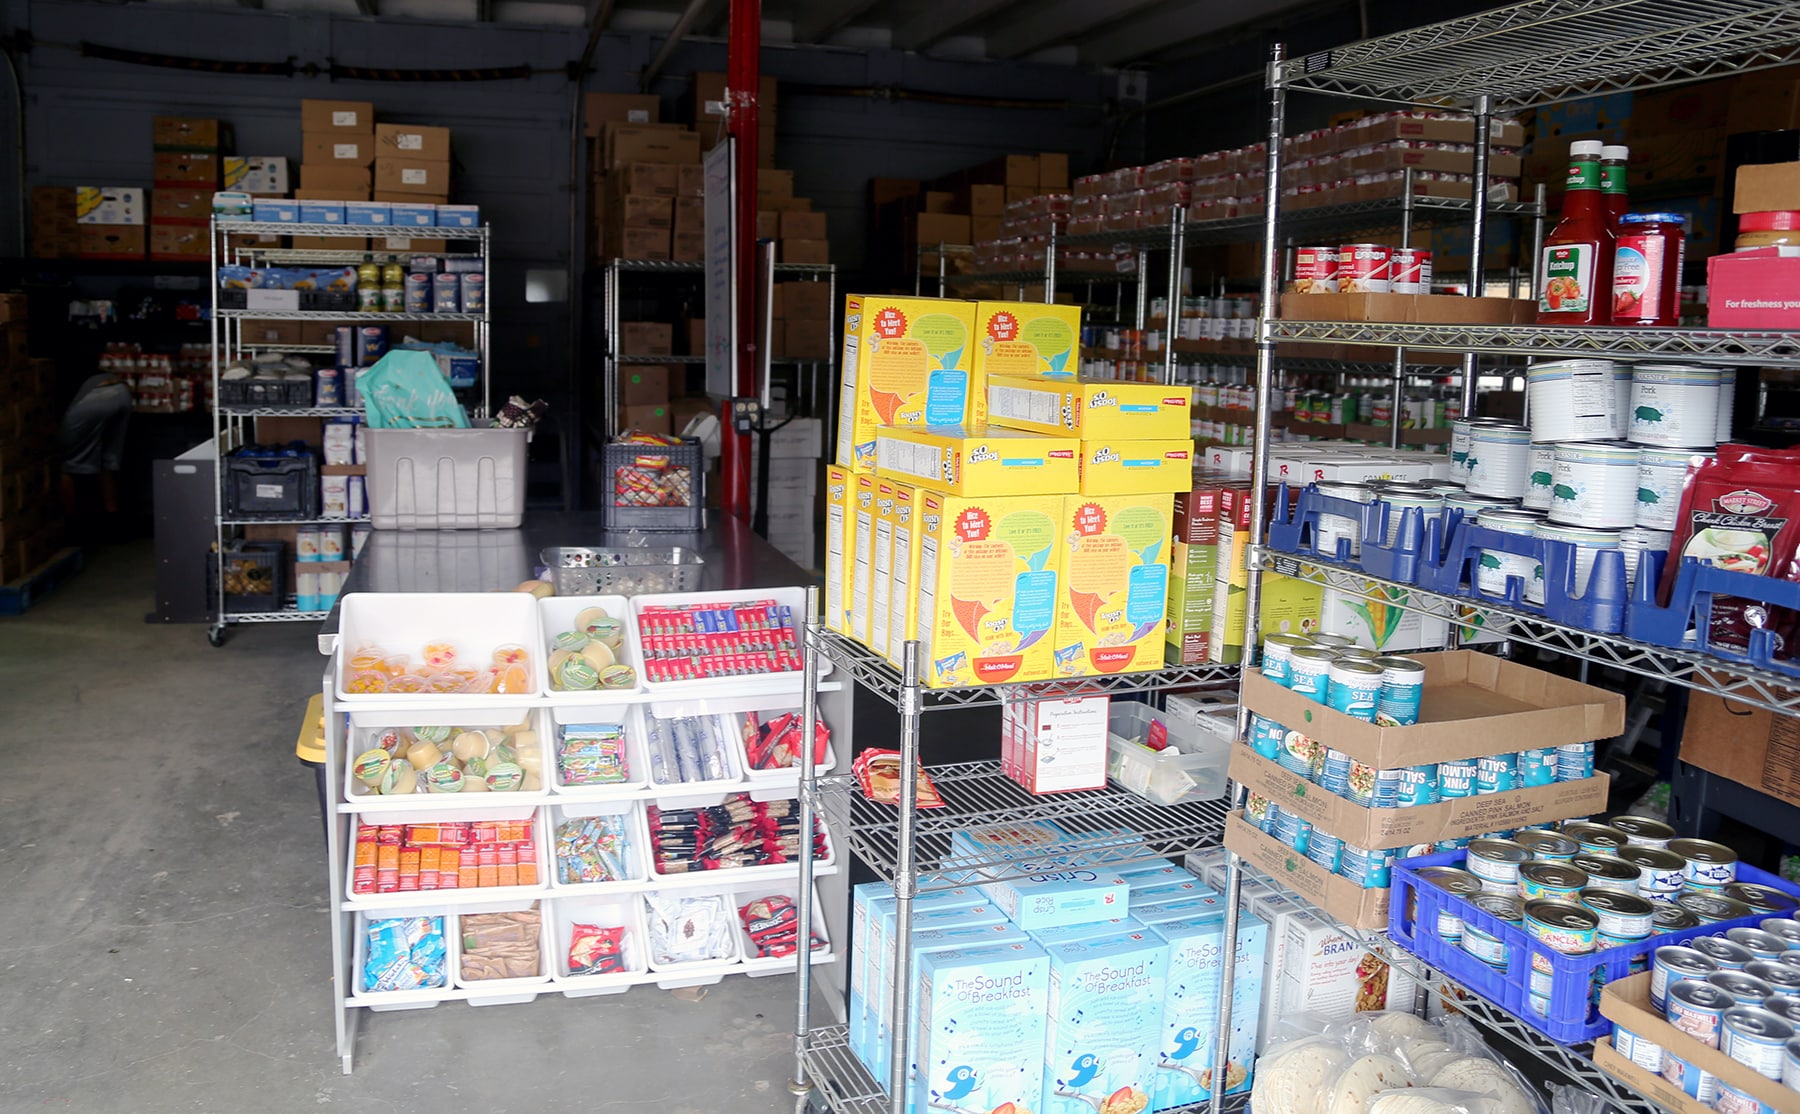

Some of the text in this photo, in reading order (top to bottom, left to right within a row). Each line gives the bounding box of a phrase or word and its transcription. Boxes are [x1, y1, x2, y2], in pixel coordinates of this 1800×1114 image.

[1549, 260, 1575, 271] Ketchup
[1725, 300, 1740, 308] For
[1741, 299, 1782, 309] freshness
[1641, 385, 1656, 394] Pork
[1537, 452, 1551, 461] Pork
[1557, 463, 1571, 472] Pork
[1723, 498, 1767, 507] MARKET STREET
[1692, 512, 1783, 529] Chunk Chicken Breast
[1264, 659, 1283, 671] SEA
[1293, 674, 1314, 686] SEA
[1351, 691, 1374, 701] SEA
[1439, 766, 1477, 777] SALMO
[1478, 759, 1508, 772] SALM
[1444, 777, 1470, 789] PINK
[1478, 771, 1496, 783] PIN
[1264, 770, 1286, 788] CANNED
[1304, 792, 1328, 809] ALMON
[1476, 798, 1506, 809] DEEP SEA
[1531, 805, 1545, 814] SALT
[1460, 801, 1531, 819] CANNED PINK SALMON
[1036, 896, 1054, 905] Rice
[1033, 905, 1055, 914] Crisp
[1545, 934, 1578, 946] ANCLA
[1186, 948, 1202, 958] The
[1323, 941, 1354, 956] BRAN
[1187, 958, 1200, 968] Of
[1084, 960, 1144, 983] The Sound
[955, 970, 1023, 990] The Sound
[1085, 976, 1151, 994] Of Breakfast
[957, 986, 1030, 1003] Of Breakfast
[1684, 1008, 1713, 1023] MAXWELL
